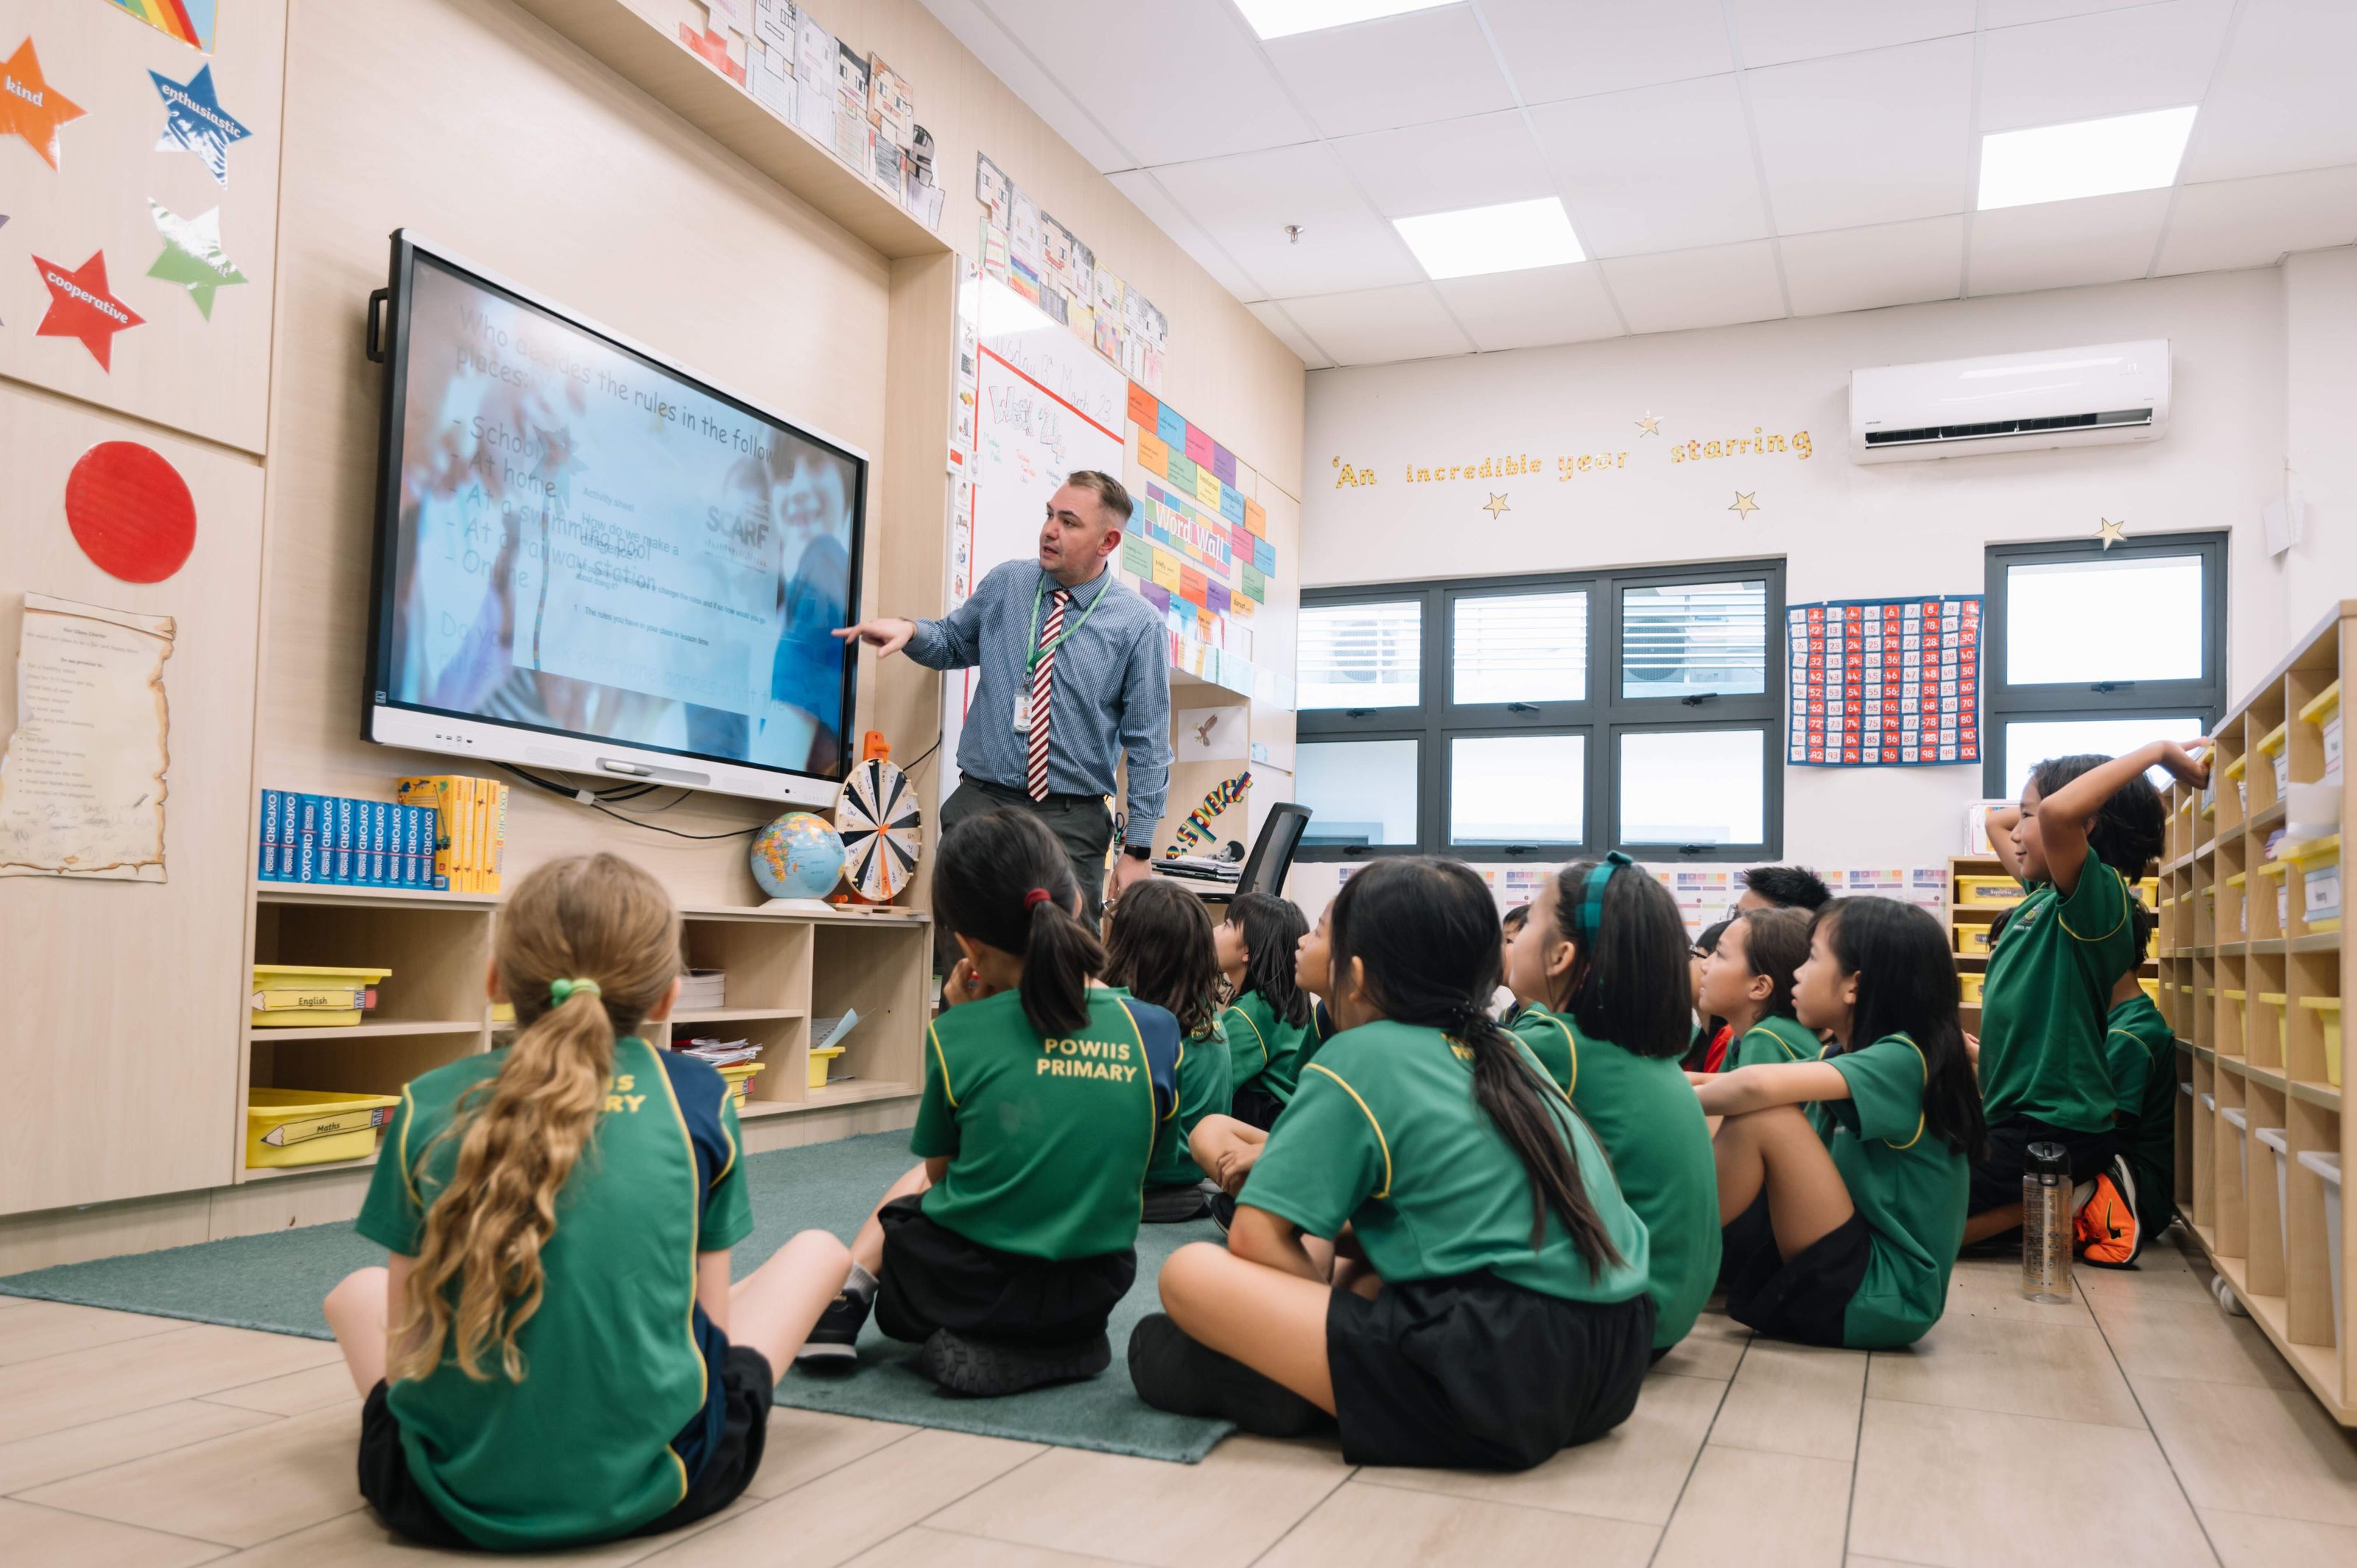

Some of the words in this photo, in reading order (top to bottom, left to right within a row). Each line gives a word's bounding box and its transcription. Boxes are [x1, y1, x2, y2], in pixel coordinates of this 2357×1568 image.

[6, 75, 43, 108] kind
[161, 83, 241, 138] enthusiastic
[47, 270, 129, 324] cooperative
[455, 345, 529, 388] places:
[459, 303, 509, 347] Who
[516, 337, 592, 384] decides
[597, 370, 628, 401] the
[634, 390, 677, 422] rules
[682, 406, 696, 431] in
[701, 415, 728, 443] the
[733, 428, 795, 479] followg
[1095, 394, 1112, 423] 23
[471, 415, 542, 460] School
[1406, 454, 1542, 483] incredible
[1558, 448, 1630, 482] year
[1670, 426, 1813, 465] starring
[468, 449, 496, 475] At
[504, 457, 558, 499] home
[466, 483, 493, 510] At
[501, 499, 513, 517] a
[583, 486, 613, 506] Activity
[614, 499, 635, 513] sheet
[464, 517, 492, 544] At
[582, 513, 607, 531] How
[610, 522, 622, 536] do
[625, 529, 641, 542] we
[643, 535, 670, 553] make
[672, 546, 679, 556] a
[705, 504, 770, 550] SCARF
[1155, 502, 1191, 544] Word
[1196, 525, 1224, 563] Wall
[658, 586, 679, 600] change
[597, 609, 613, 621] rules
[625, 616, 639, 627] have
[659, 626, 674, 636] class
[680, 630, 698, 643] lesson
[1925, 639, 1937, 647] 28
[1927, 621, 1936, 629] 18
[1886, 687, 1897, 695] 56
[1924, 686, 1935, 694] 58
[1961, 683, 1972, 692] 60
[1925, 669, 1936, 678] 48
[1963, 667, 1973, 675] 50
[1810, 720, 1822, 728] 72
[1886, 719, 1897, 727] 76
[1925, 718, 1936, 726] 78
[1961, 715, 1972, 723] 80
[1811, 704, 1822, 712] 62
[1885, 703, 1896, 711] 66
[1924, 702, 1935, 710] 68
[1810, 735, 1822, 743] 82
[1846, 735, 1856, 743] 84
[1886, 734, 1897, 742] 86
[1962, 731, 1973, 739] 90
[1845, 751, 1856, 759] 94
[1884, 751, 1896, 759] 96
[1922, 750, 1933, 758] 98
[267, 795, 277, 843] OXFORD
[285, 796, 295, 844] OXFORD
[323, 801, 332, 847] OXFORD
[340, 802, 351, 848] OXFORD
[359, 804, 368, 850] OXFORD
[375, 806, 384, 851] OXFORD
[391, 808, 401, 853] OXFORD
[408, 809, 418, 854] OXFORD
[424, 812, 433, 855] OXFORD
[496, 791, 507, 838] OXFORD
[301, 833, 313, 881] OXFORD
[298, 997, 328, 1008] English
[1036, 1058, 1138, 1084] PRIMARY
[1044, 1038, 1131, 1061] POWIIS
[317, 1122, 340, 1133] Maths
